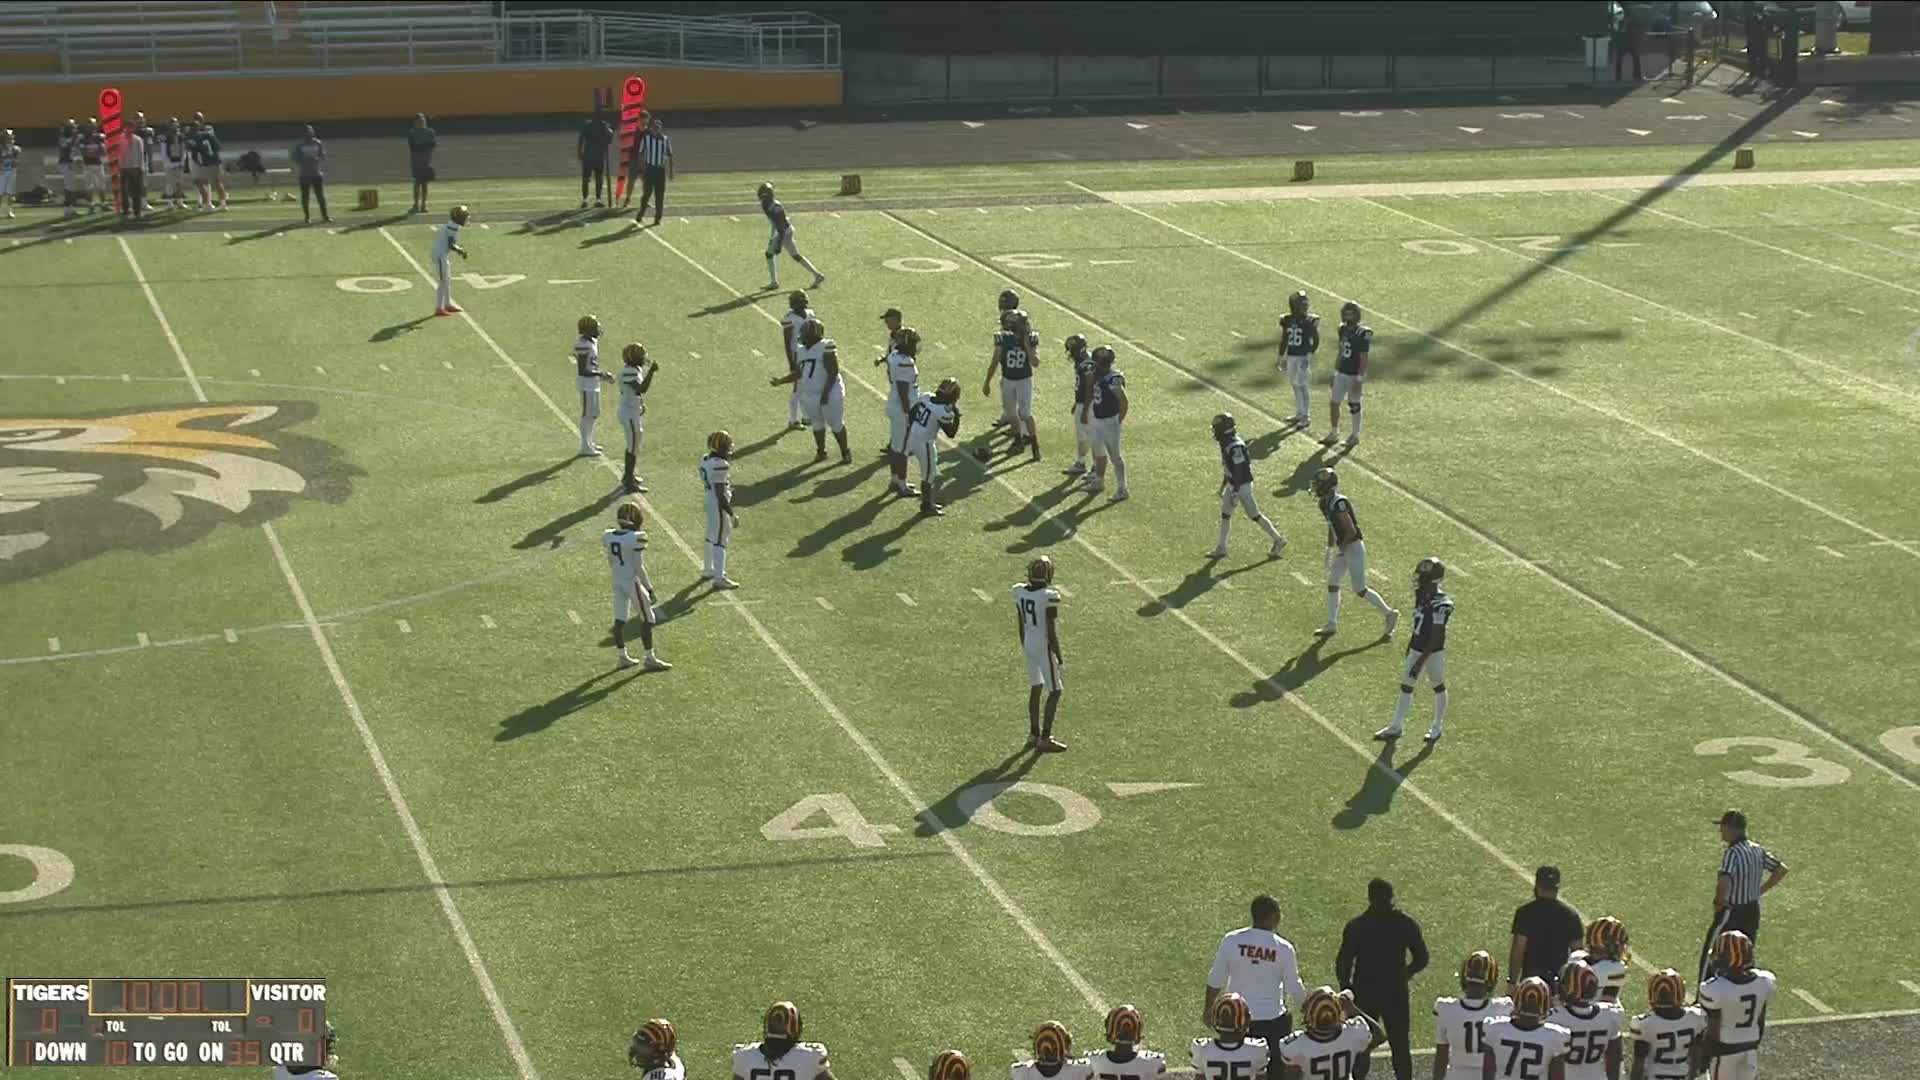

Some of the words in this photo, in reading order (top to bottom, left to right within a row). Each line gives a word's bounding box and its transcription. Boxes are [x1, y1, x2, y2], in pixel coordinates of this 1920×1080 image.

[1286, 327, 1303, 347] 26
[610, 542, 625, 566] 9
[1020, 597, 1038, 626] 19
[1238, 944, 1277, 963] TEAM
[1735, 994, 1757, 1028] 3
[1501, 1039, 1543, 1080] 72
